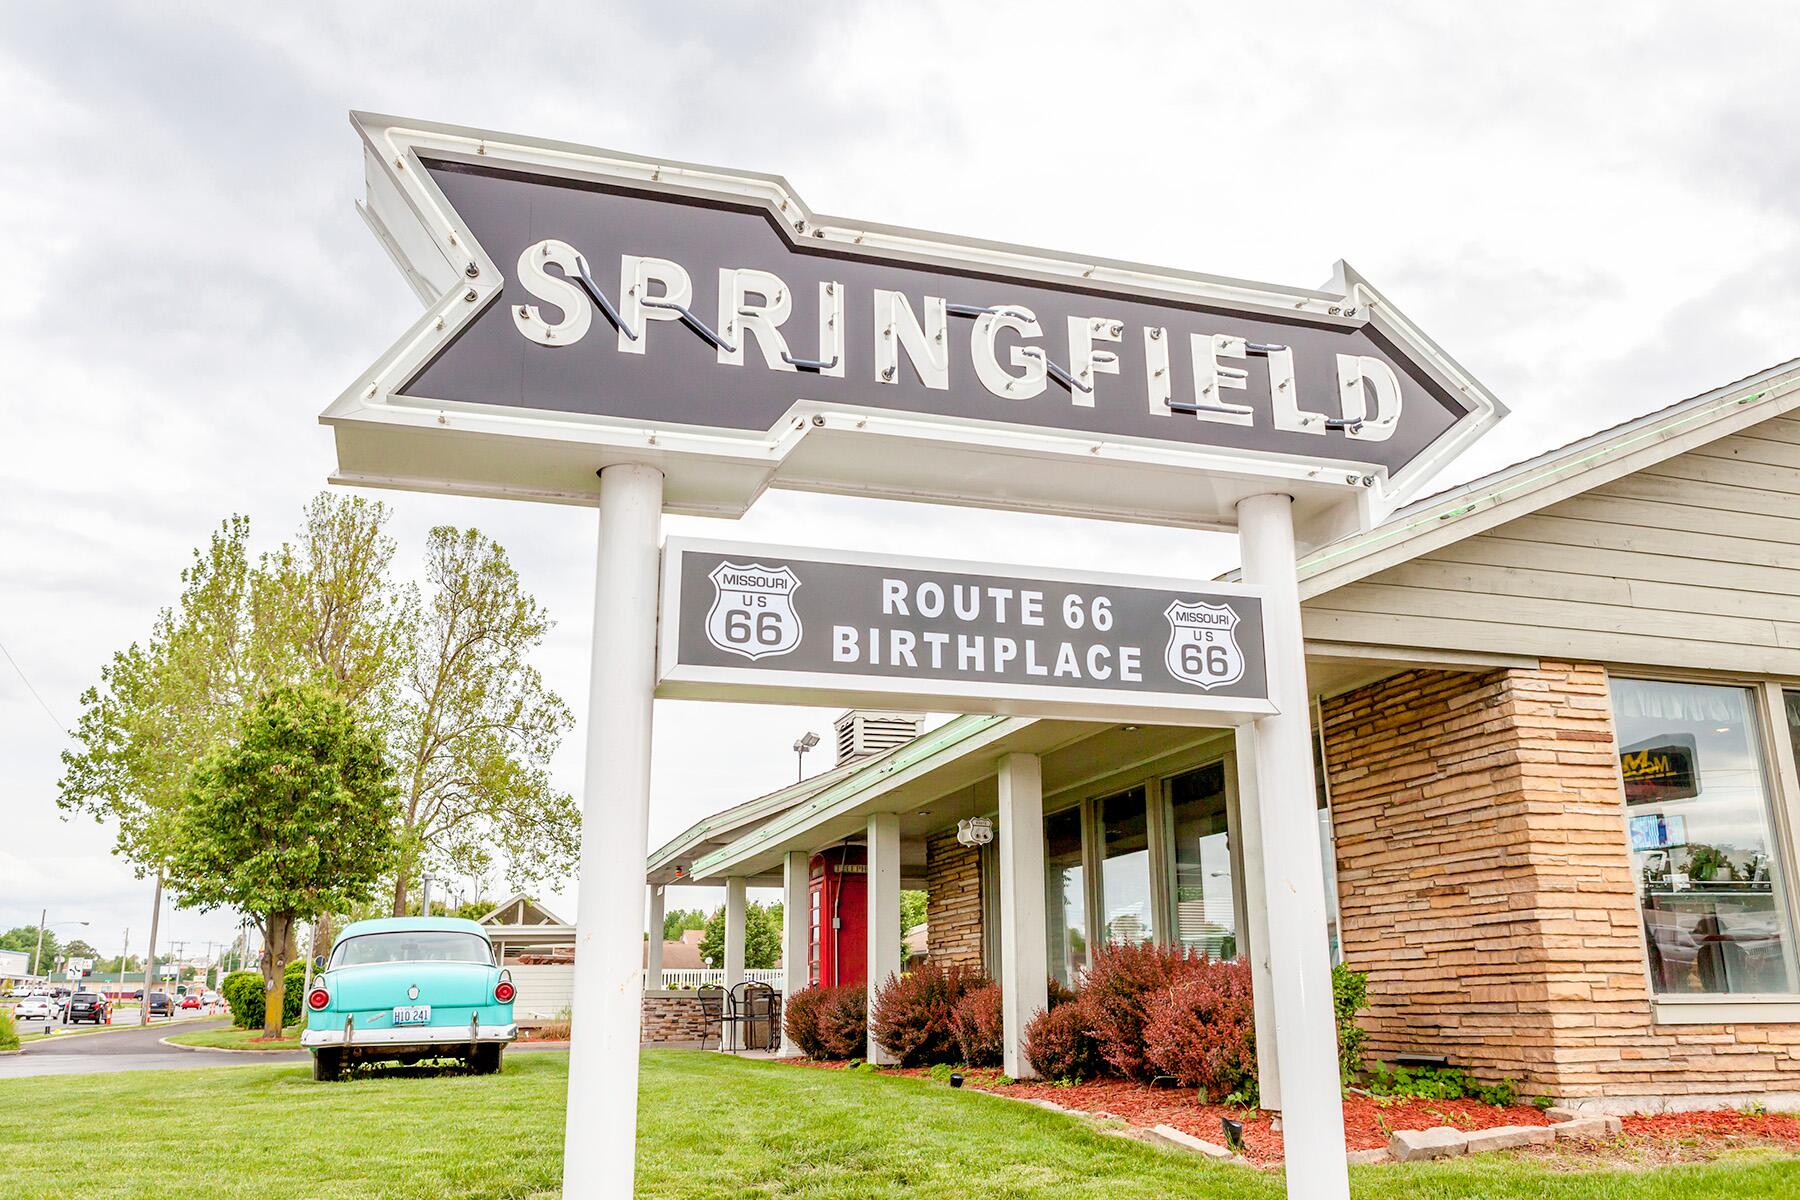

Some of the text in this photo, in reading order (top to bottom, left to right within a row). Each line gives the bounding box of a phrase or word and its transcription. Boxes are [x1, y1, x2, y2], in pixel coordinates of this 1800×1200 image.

[511, 239, 1403, 442] SPRINGFIELD
[722, 573, 788, 589] MISSOURI
[882, 578, 1114, 632] ROUTE 66
[1175, 611, 1230, 625] MISSOURI
[724, 609, 783, 646] 66
[832, 625, 1143, 682] BIRTHPLACE
[1181, 643, 1229, 676] 66
